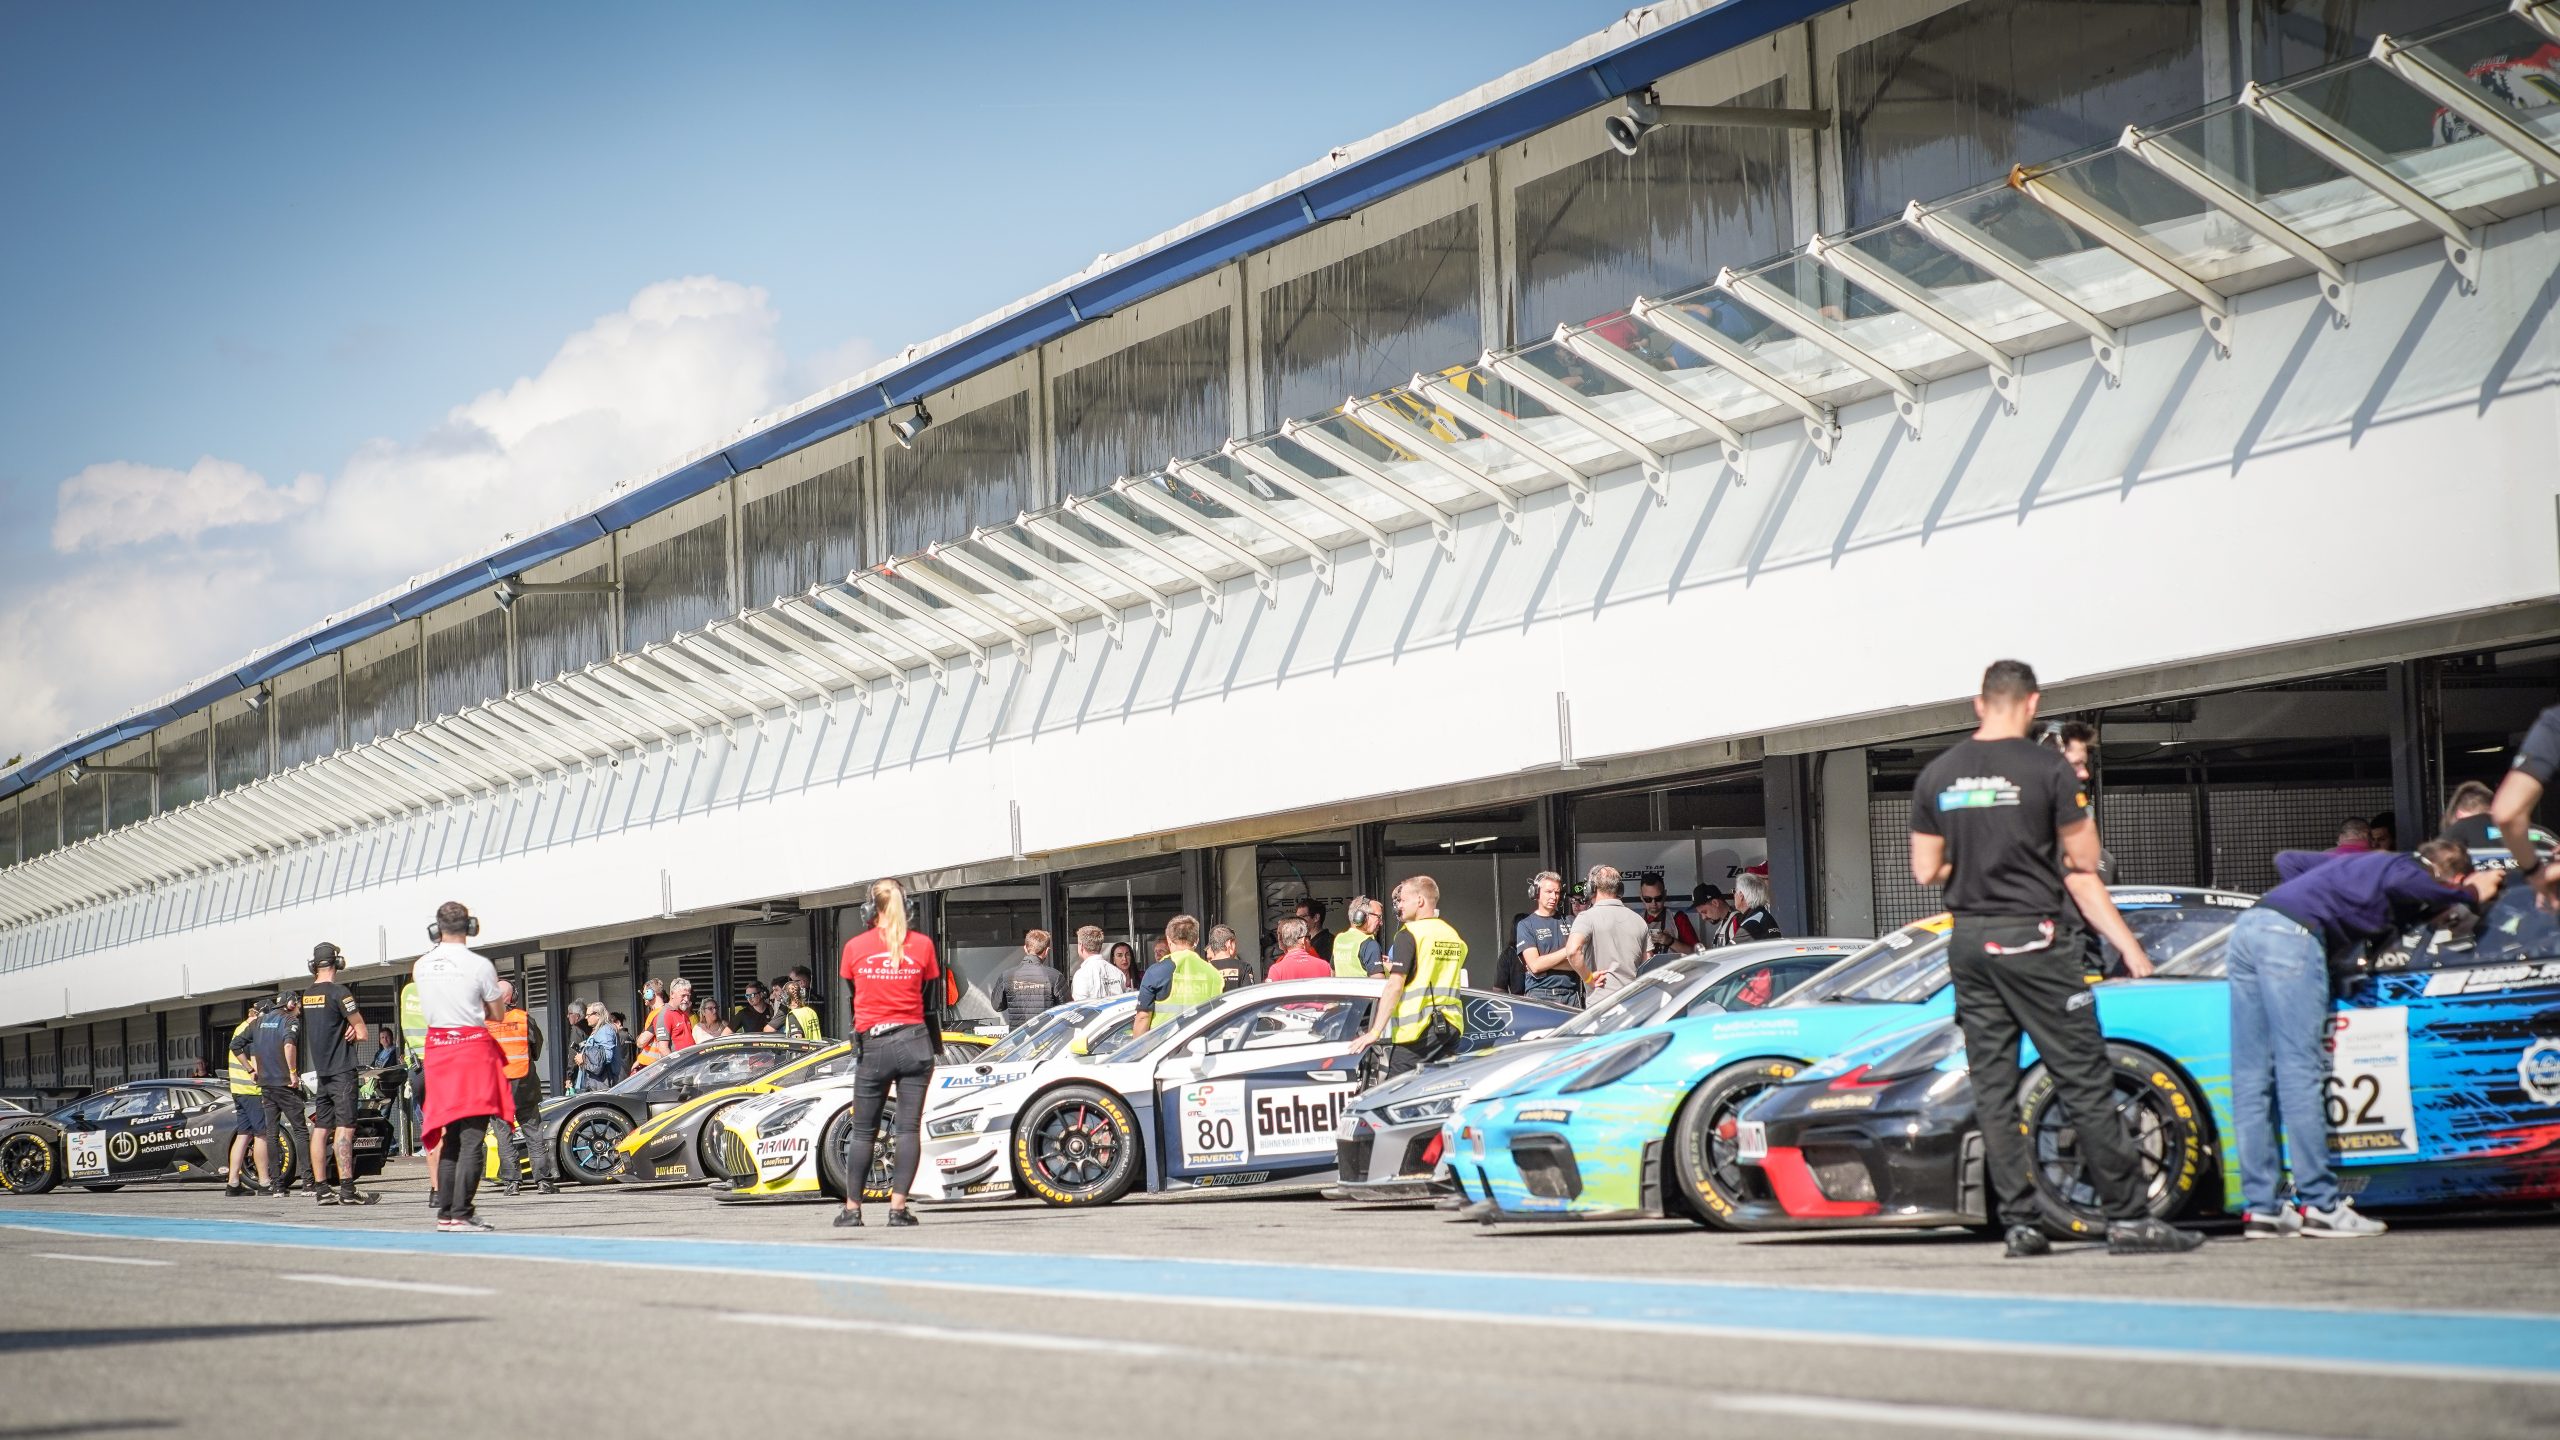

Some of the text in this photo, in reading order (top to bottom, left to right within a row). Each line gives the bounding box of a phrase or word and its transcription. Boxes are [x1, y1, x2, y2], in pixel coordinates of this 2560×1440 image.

[1470, 1031, 1515, 1040] GEBAU
[941, 1073, 1026, 1089] ZAKSPEED
[2322, 1074, 2385, 1127] 62
[130, 1114, 175, 1126] Fastron
[1099, 1098, 1130, 1134] EAGLE
[1258, 1091, 1354, 1136] Schell
[140, 1125, 214, 1145] DÖRR GROUP
[563, 1117, 580, 1143] EAGLE
[1198, 1118, 1233, 1150] 80
[141, 1141, 189, 1154] HÖCHSTLEISTUNG
[1316, 1136, 1337, 1145] TECH
[2329, 1134, 2400, 1150] VENOL
[76, 1151, 97, 1169] 49
[763, 1158, 790, 1167] GOODYEAR
[1192, 1153, 1239, 1163] RAVENOL
[1018, 1139, 1073, 1203] GOODYEAR
[967, 1182, 1010, 1193] GOODYEAR
